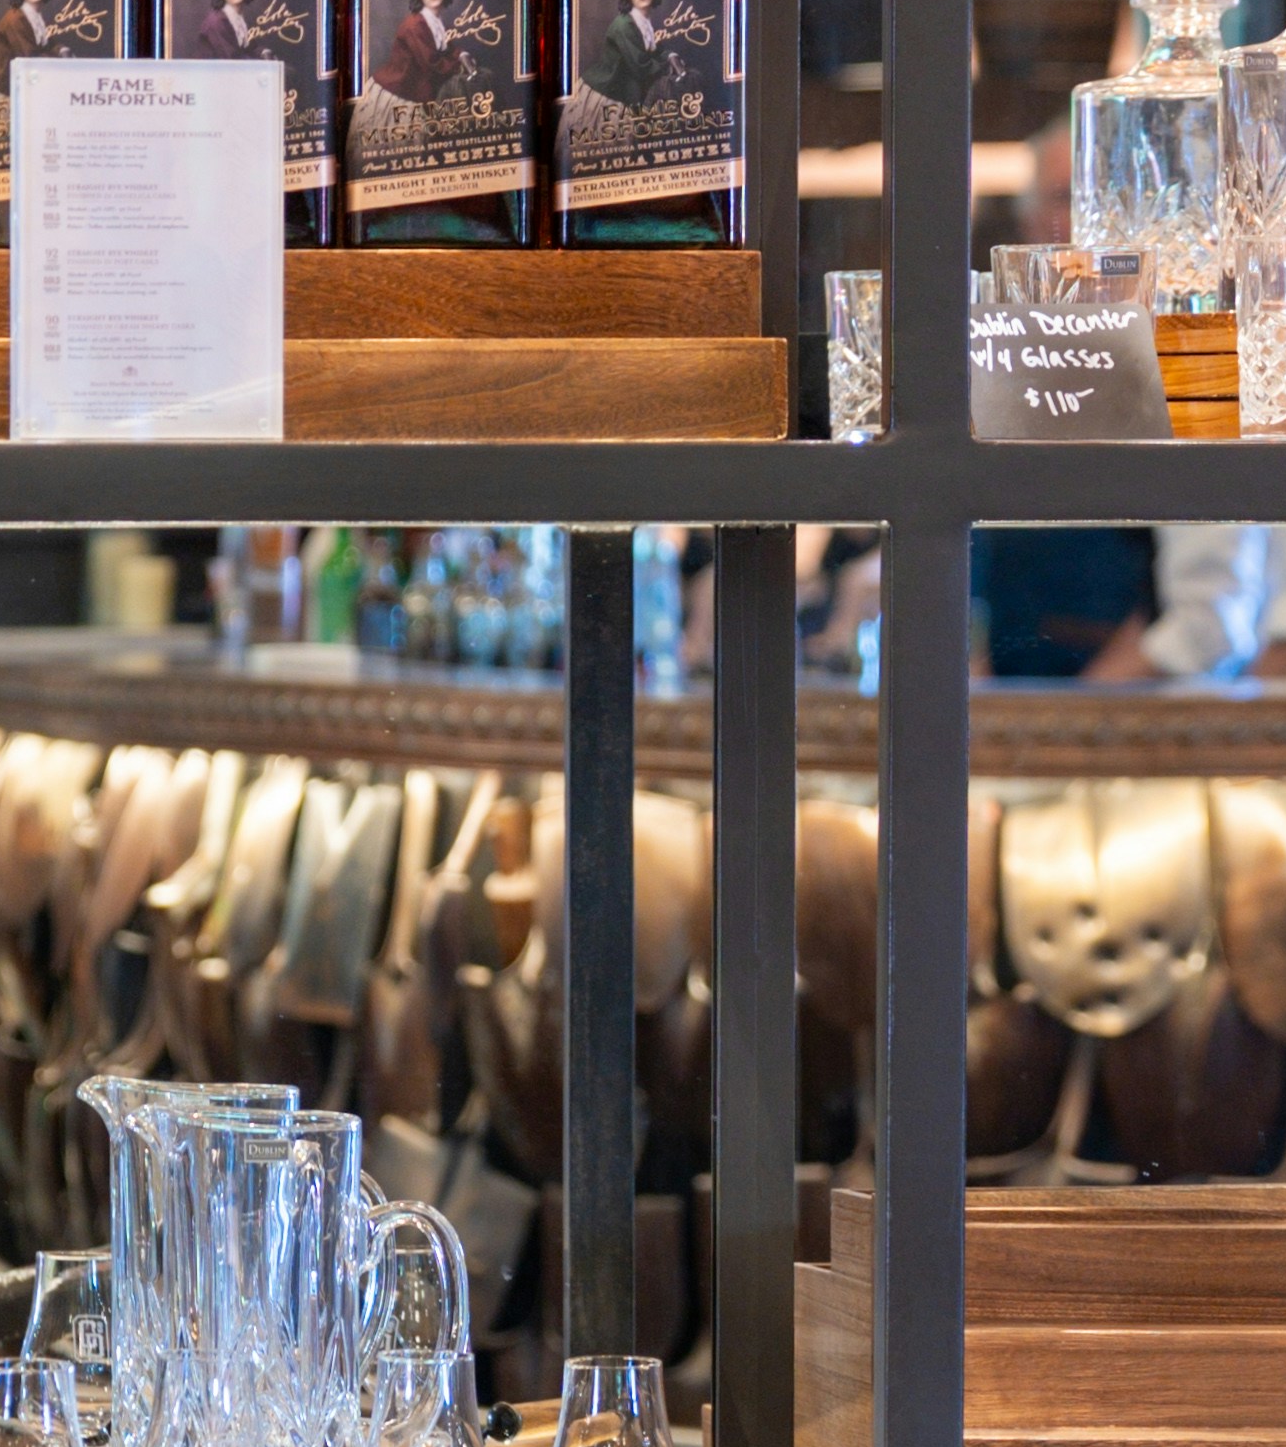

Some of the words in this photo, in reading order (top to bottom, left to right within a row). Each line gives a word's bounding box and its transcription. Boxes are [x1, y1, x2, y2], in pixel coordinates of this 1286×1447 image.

[454, 0, 490, 28] Lola
[664, 0, 699, 28] Lola
[97, 77, 154, 92] FAME
[69, 92, 196, 106] MISFORTUNE
[393, 97, 469, 123] FAME
[471, 90, 494, 119] &
[603, 98, 678, 124] FAME
[680, 91, 704, 119] &
[359, 108, 526, 146] MISFORTUNE
[569, 110, 734, 147] MISFORTUNE
[380, 145, 426, 157] CALISTOGA
[455, 135, 502, 148] DISTILLERY
[391, 155, 439, 171] LOLA
[443, 142, 523, 165] MONTEZ
[589, 144, 635, 157] CALISTOGA
[665, 134, 712, 147] DISTILLERY
[600, 155, 648, 171] LOLA
[653, 142, 732, 164] MONTEZ
[364, 178, 426, 194] STRAIGHT
[432, 173, 457, 185] RYE
[460, 166, 517, 182] WHISKEY
[568, 191, 612, 205] FINISHED
[614, 188, 625, 199] IN
[627, 184, 660, 196] CREAM
[663, 180, 698, 193] SHERRY
[701, 176, 732, 187] CASKS
[573, 177, 636, 194] STRAIGHT
[642, 172, 665, 184] RYE
[670, 165, 727, 181] WHISKEY
[1103, 258, 1138, 270] DUBLIN
[1029, 308, 1138, 336] Decanter
[1020, 345, 1115, 370] Glasses
[248, 1143, 287, 1155] DUBLIN
